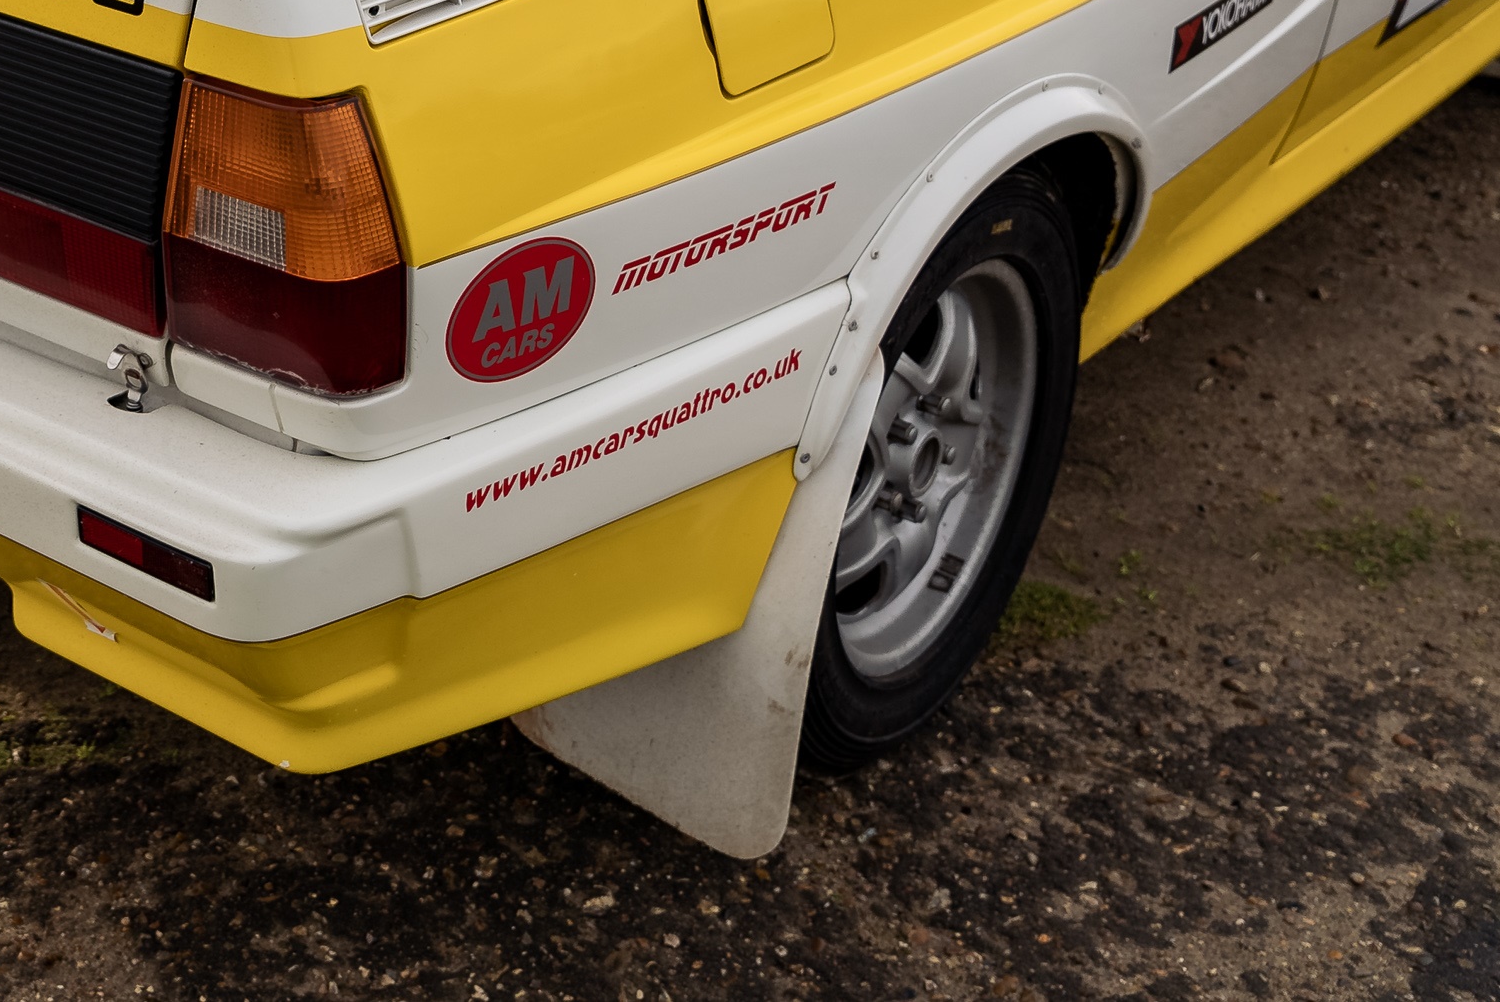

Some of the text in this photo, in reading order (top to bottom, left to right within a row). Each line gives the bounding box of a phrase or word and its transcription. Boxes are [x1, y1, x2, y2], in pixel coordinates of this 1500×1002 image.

[611, 181, 837, 296] MOTORSPORT
[472, 255, 575, 343] AM
[481, 323, 556, 368] CARS
[465, 348, 802, 512] www.amcarsquattro.co.uk
